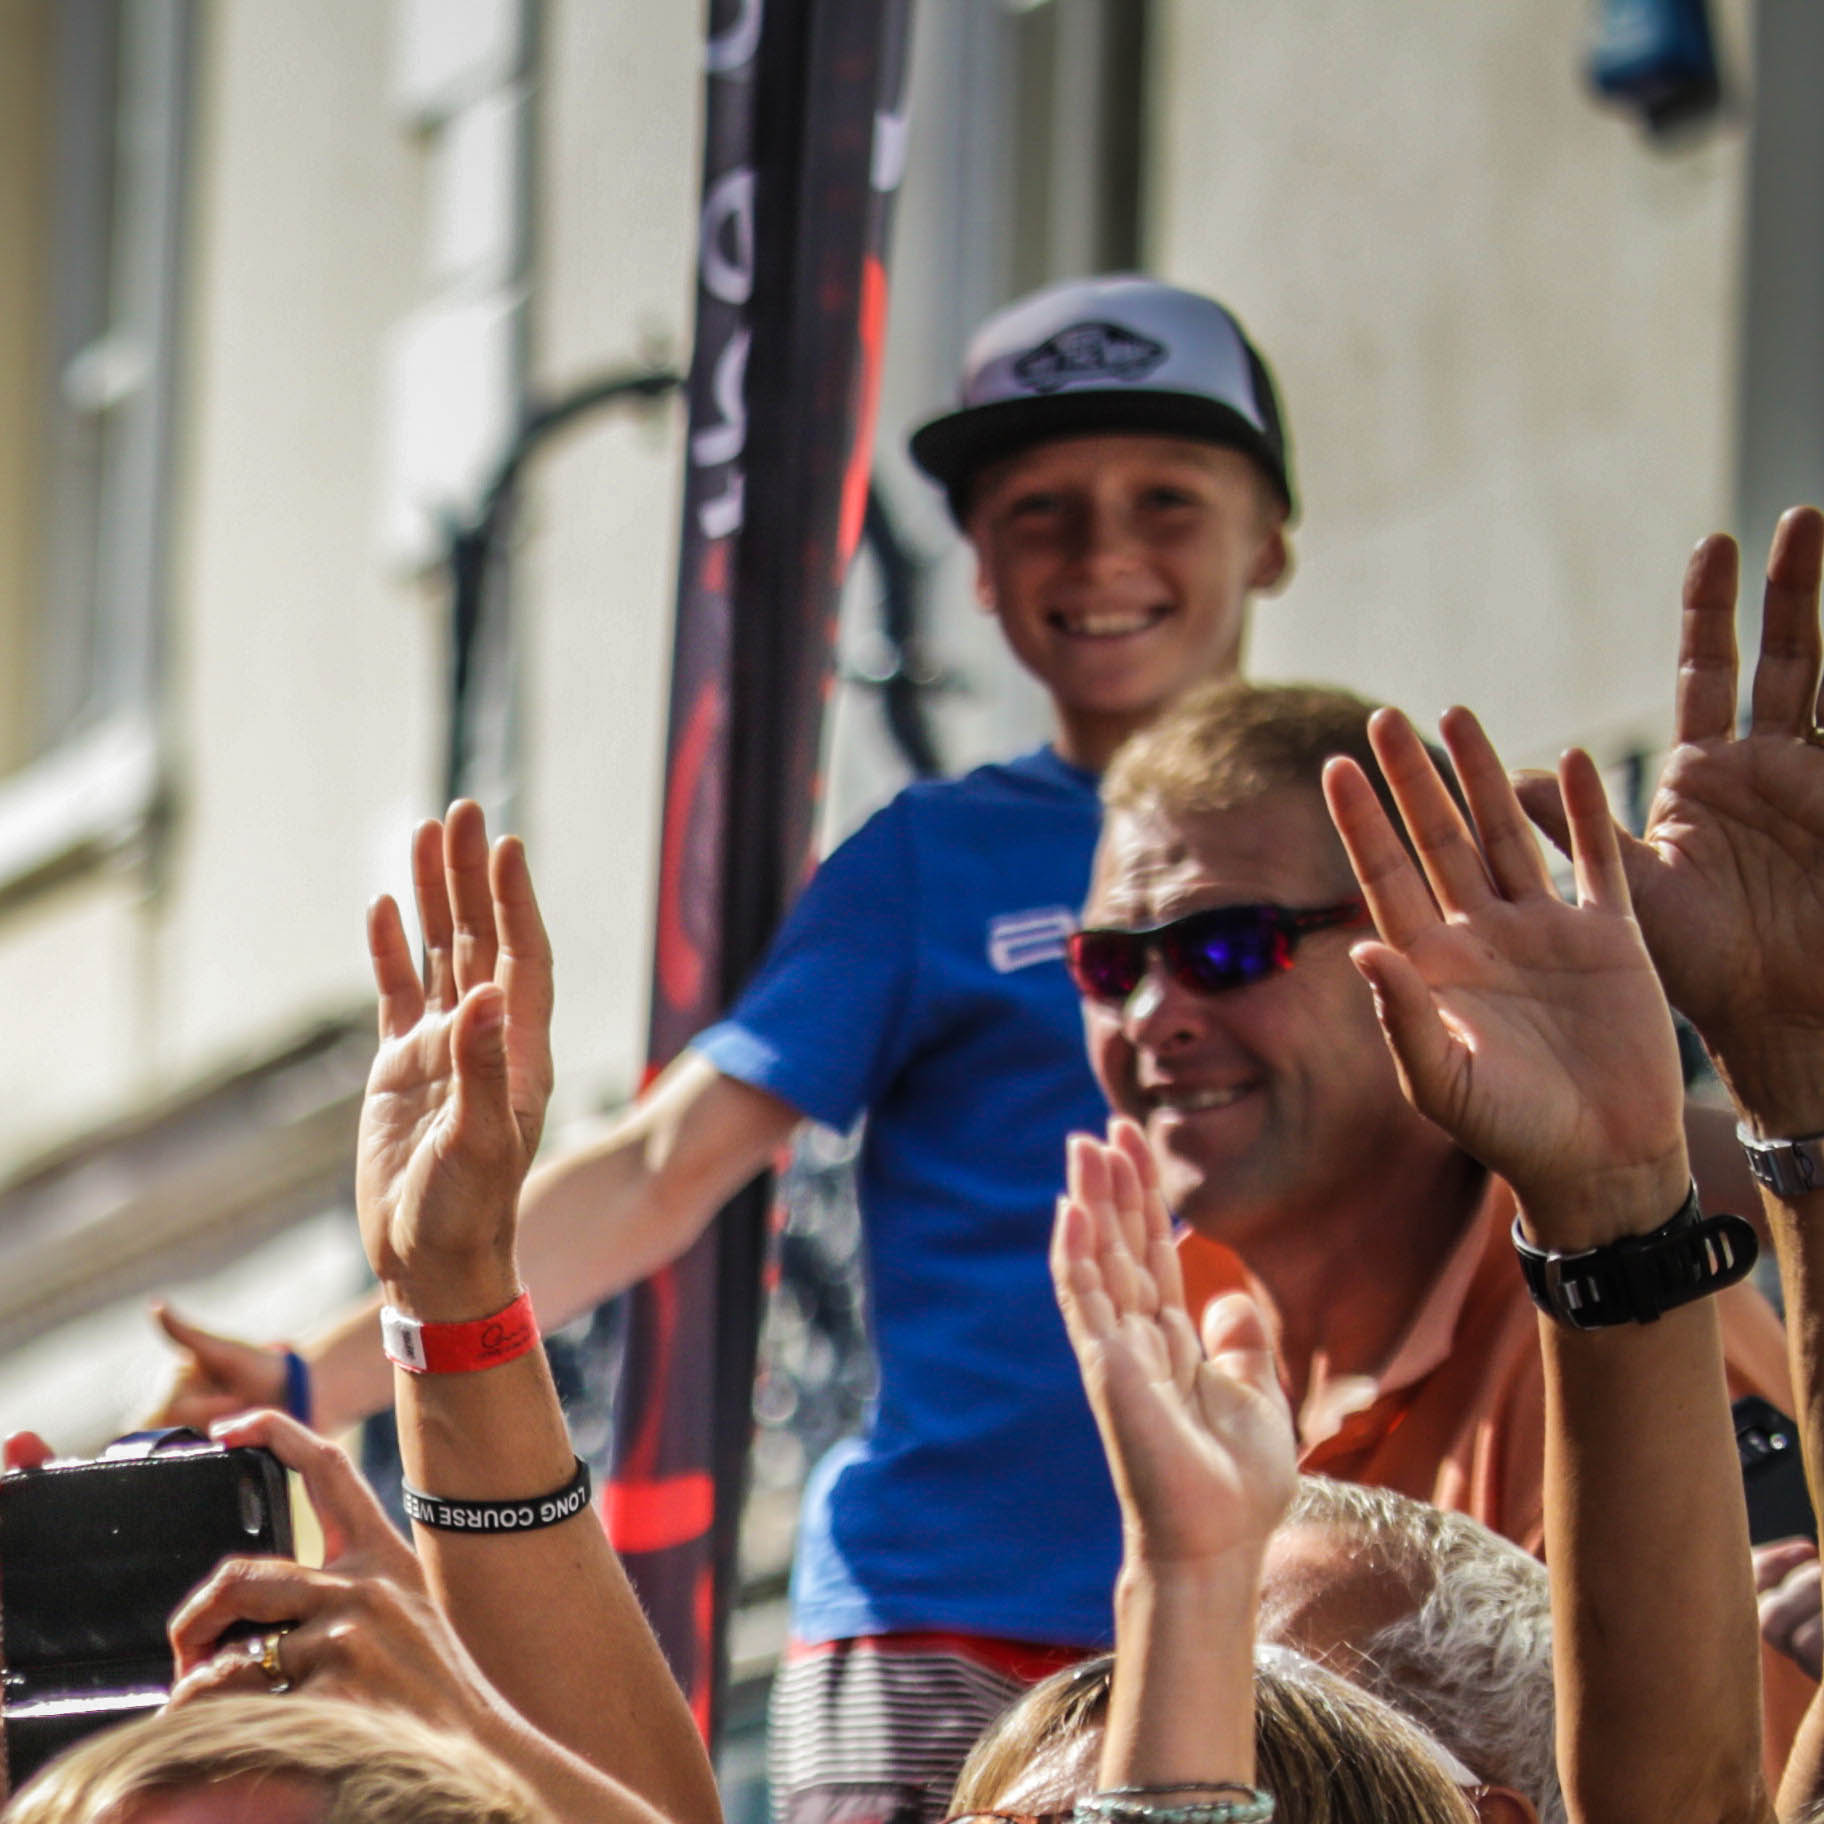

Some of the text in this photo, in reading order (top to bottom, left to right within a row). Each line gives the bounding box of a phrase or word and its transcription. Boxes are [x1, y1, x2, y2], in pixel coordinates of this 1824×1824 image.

[405, 1486, 587, 1530] LONG COURSE WEE
